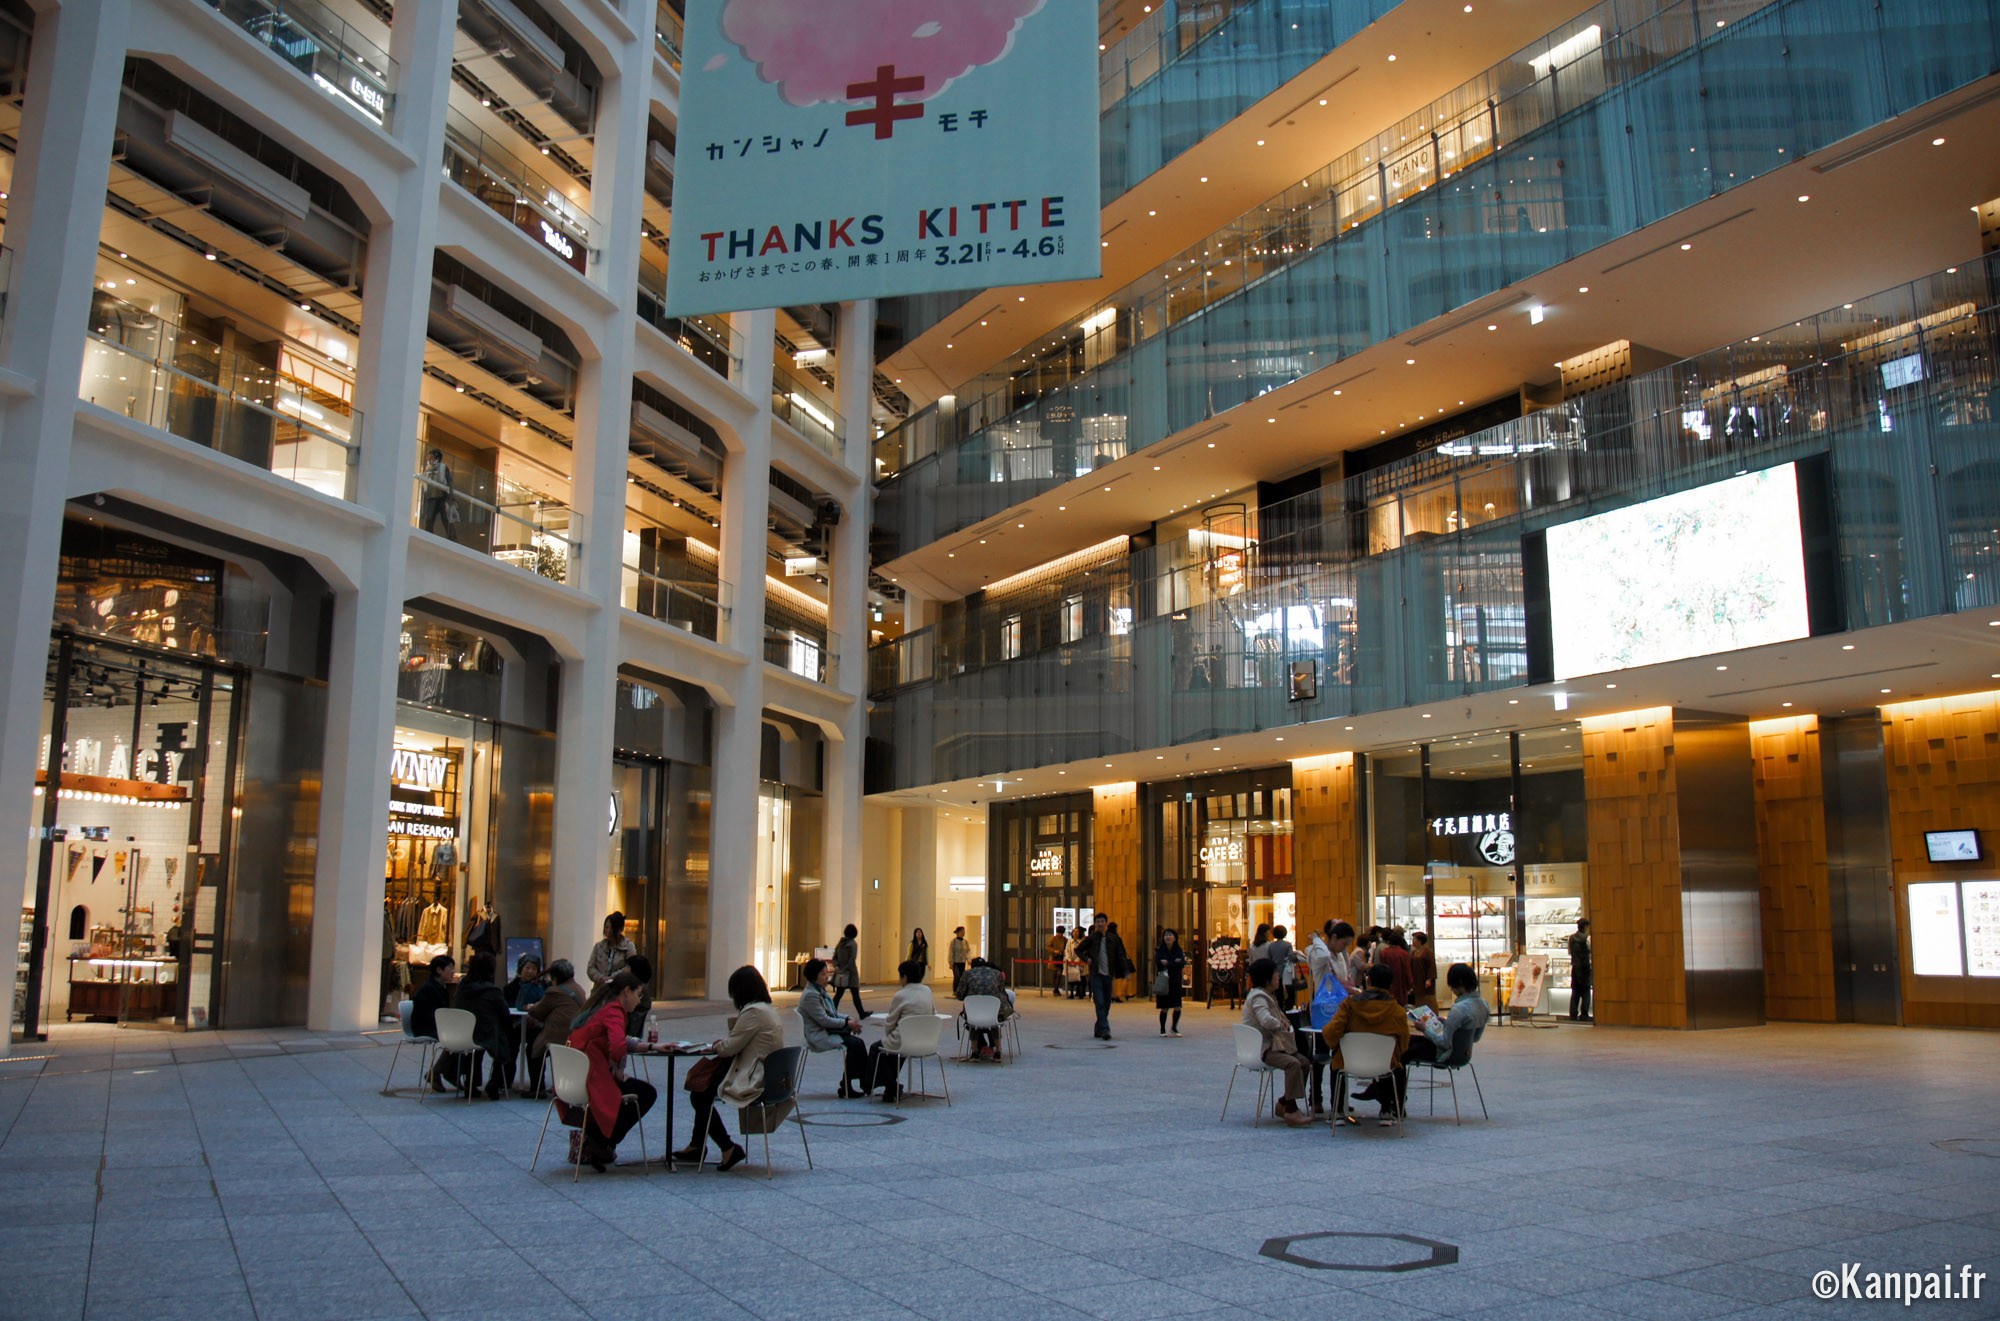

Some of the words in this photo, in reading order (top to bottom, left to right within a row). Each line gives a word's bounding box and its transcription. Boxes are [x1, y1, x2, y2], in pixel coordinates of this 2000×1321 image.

[541, 221, 573, 259] Tabio
[700, 214, 884, 262] THANKS
[918, 196, 1065, 240] KITTE
[406, 802, 423, 815] NOT
[423, 804, 445, 817] WORK
[406, 822, 454, 839] RESEARCH
